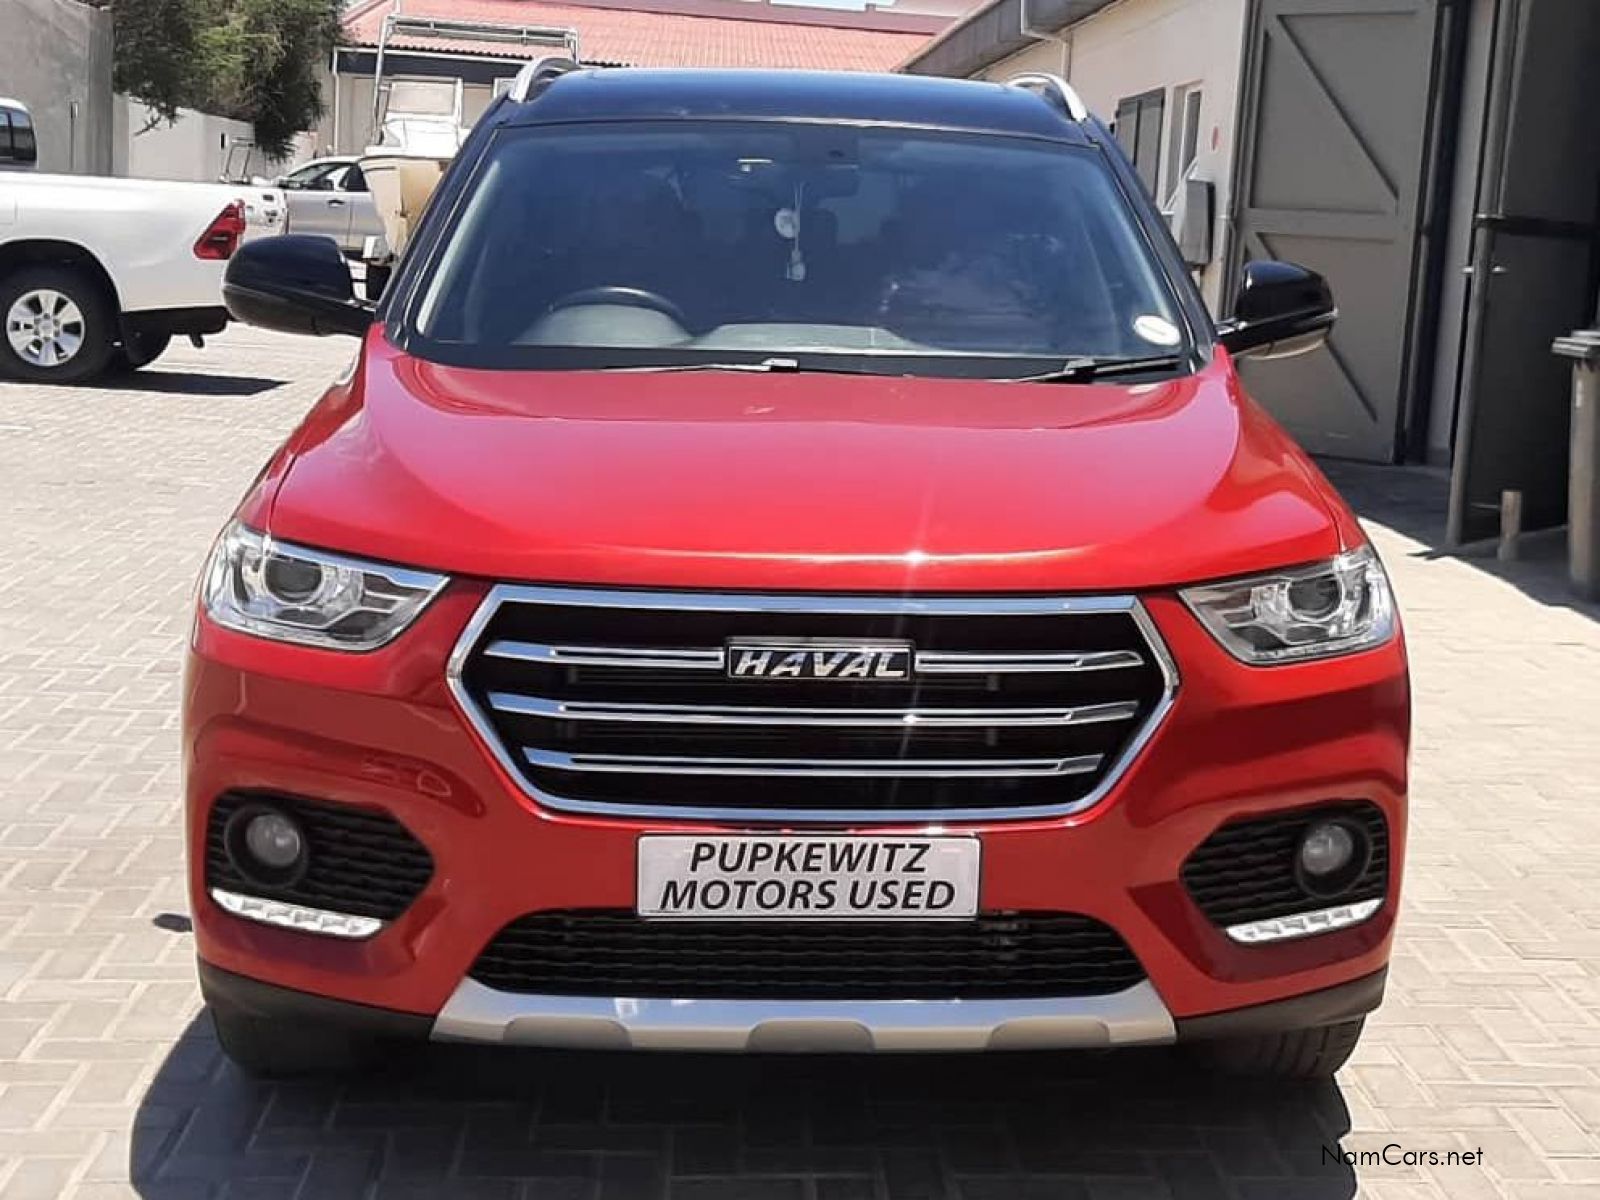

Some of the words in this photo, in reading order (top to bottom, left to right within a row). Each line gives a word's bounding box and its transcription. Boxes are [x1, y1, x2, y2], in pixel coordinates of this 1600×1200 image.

[734, 650, 905, 677] HAVAL
[689, 842, 931, 873] PUPKEWITZ
[659, 880, 837, 911] MOTORS
[848, 880, 956, 911] USED
